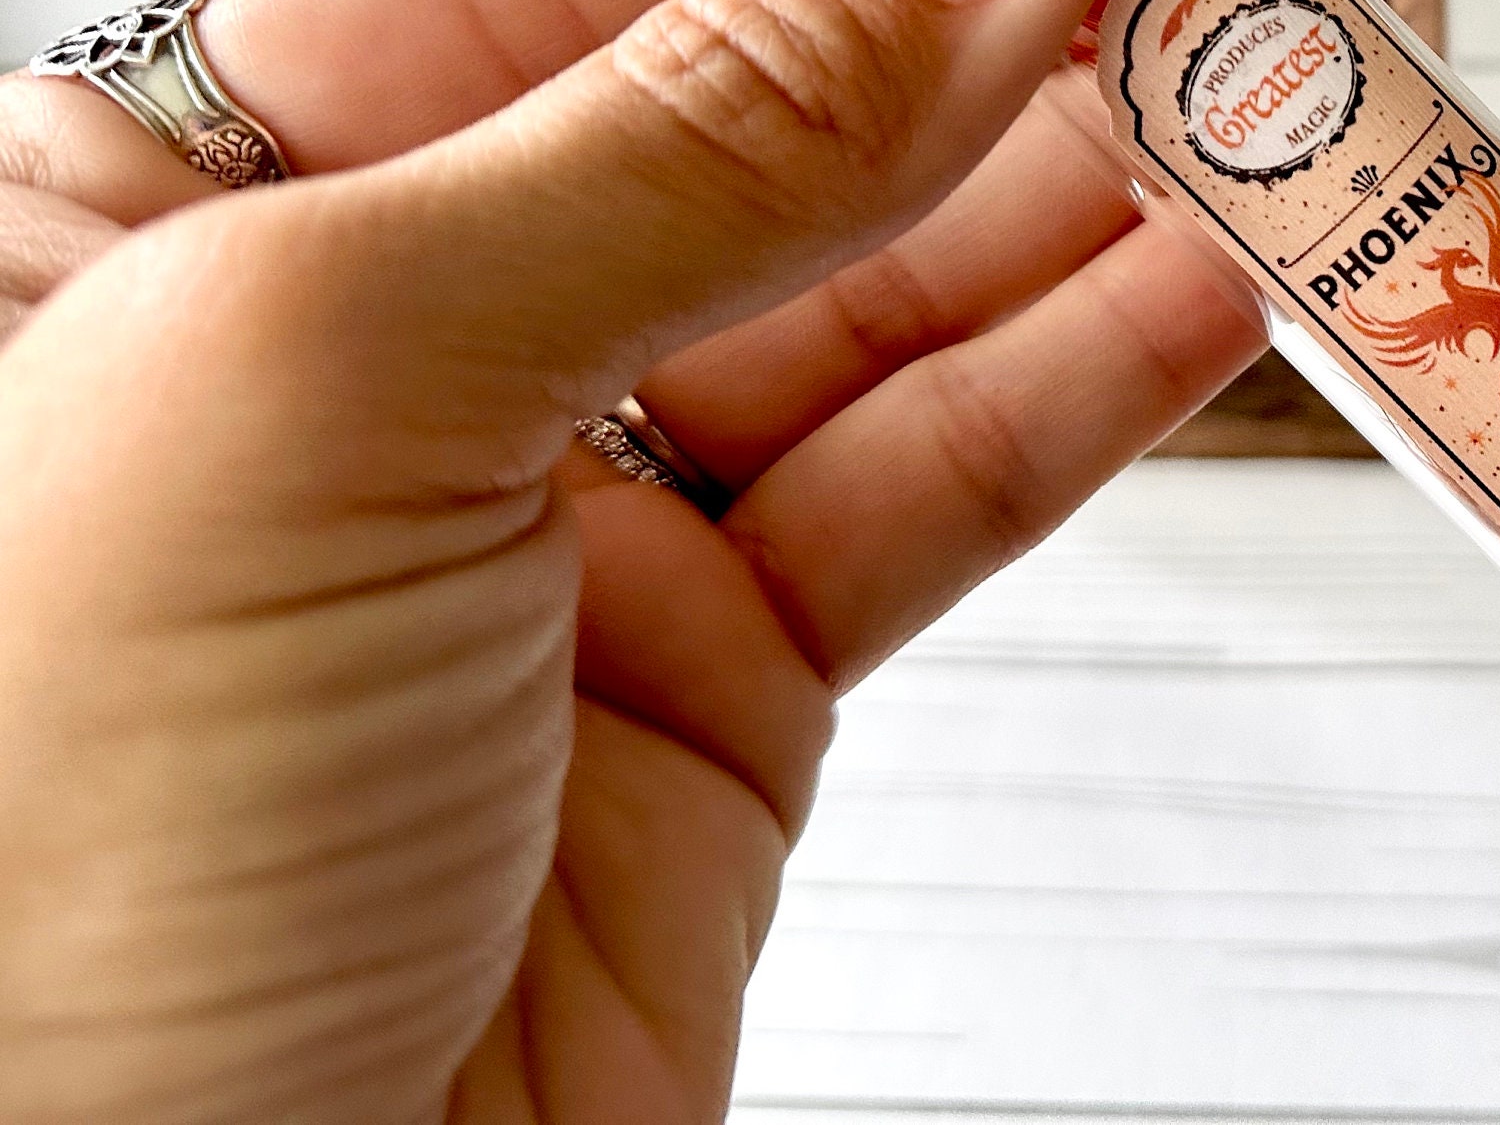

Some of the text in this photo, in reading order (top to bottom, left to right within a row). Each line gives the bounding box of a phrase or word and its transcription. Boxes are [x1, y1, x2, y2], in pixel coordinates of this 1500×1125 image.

[1203, 16, 1286, 95] PRODUCES
[1204, 22, 1337, 149] Greatest
[1285, 95, 1338, 148] MAGIC
[1306, 142, 1497, 311] PHOENIX
